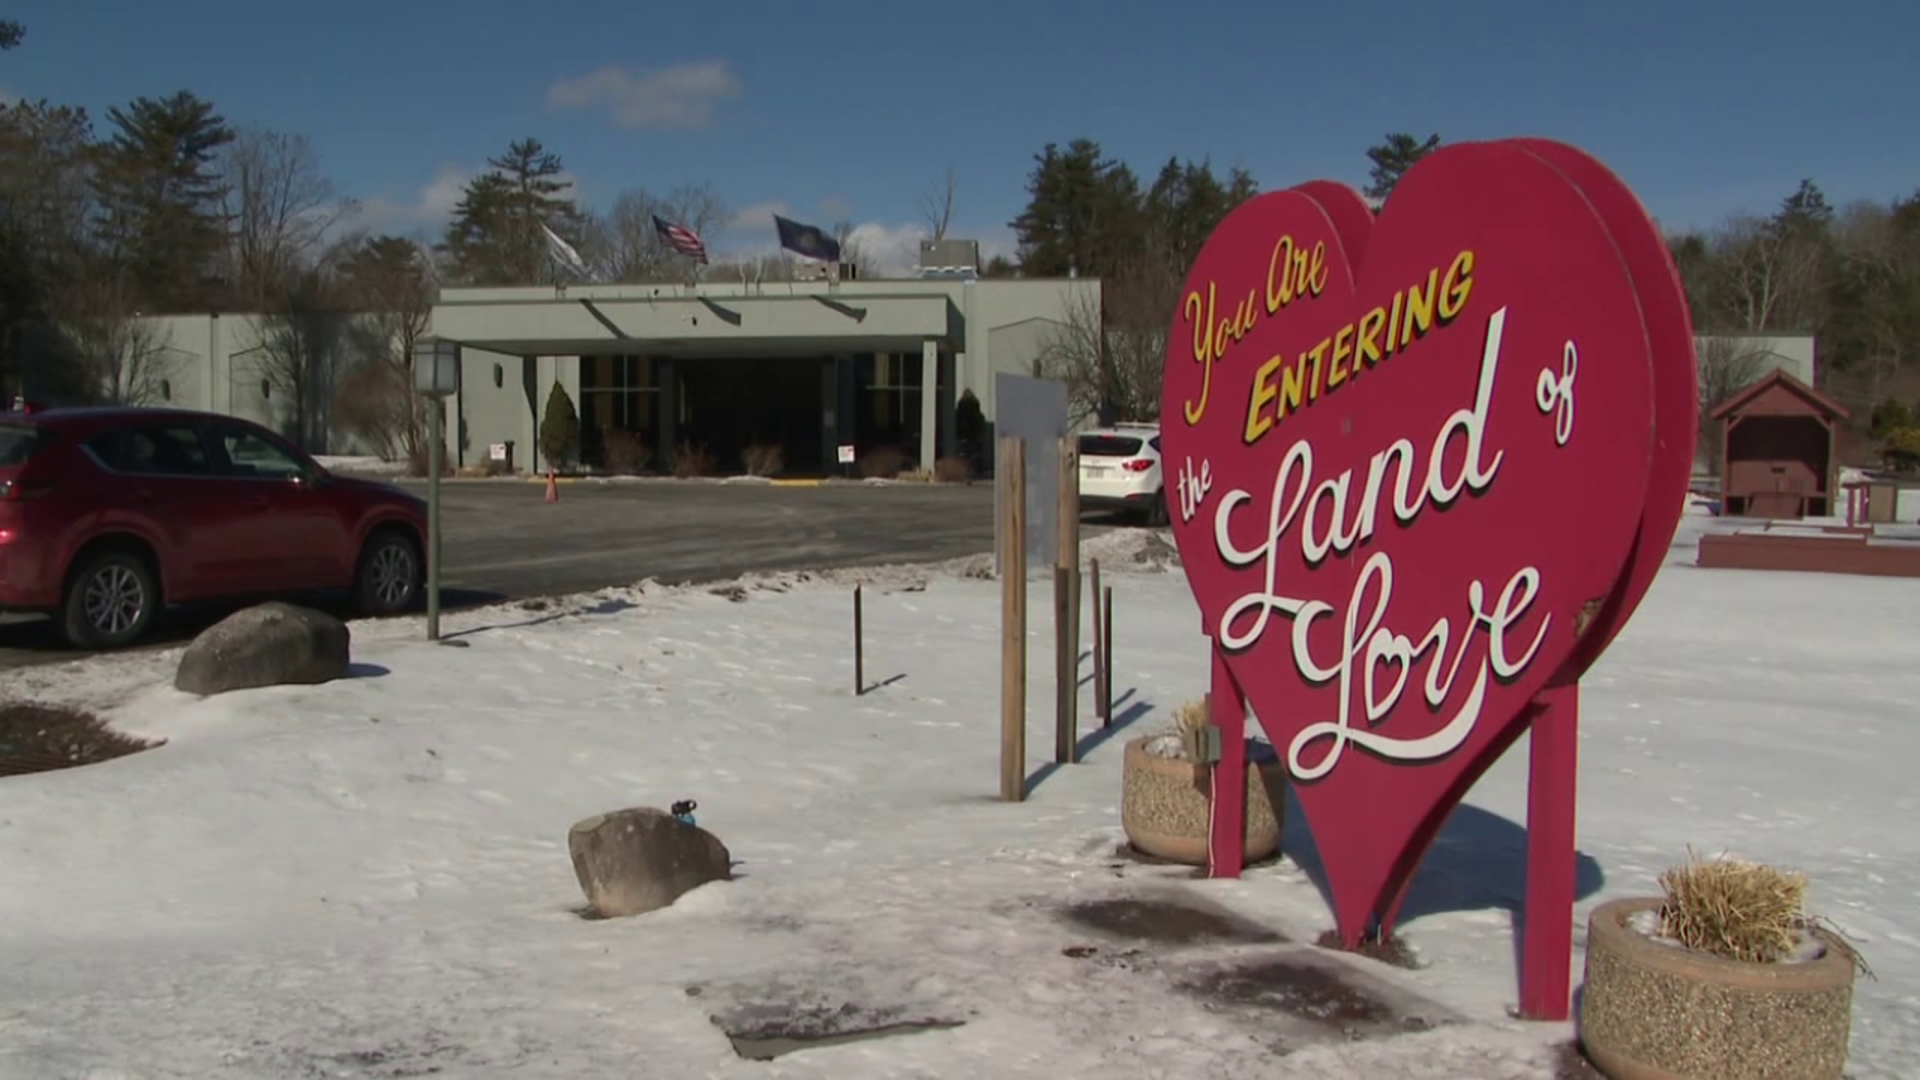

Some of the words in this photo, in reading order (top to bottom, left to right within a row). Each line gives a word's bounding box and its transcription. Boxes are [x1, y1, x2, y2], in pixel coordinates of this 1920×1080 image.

[1184, 280, 1258, 426] You
[1265, 235, 1329, 313] Are
[1243, 250, 1475, 443] ENTERING
[1177, 456, 1213, 522] the
[1214, 305, 1507, 650] Land
[1536, 339, 1578, 446] of
[1288, 552, 1552, 780] Love
